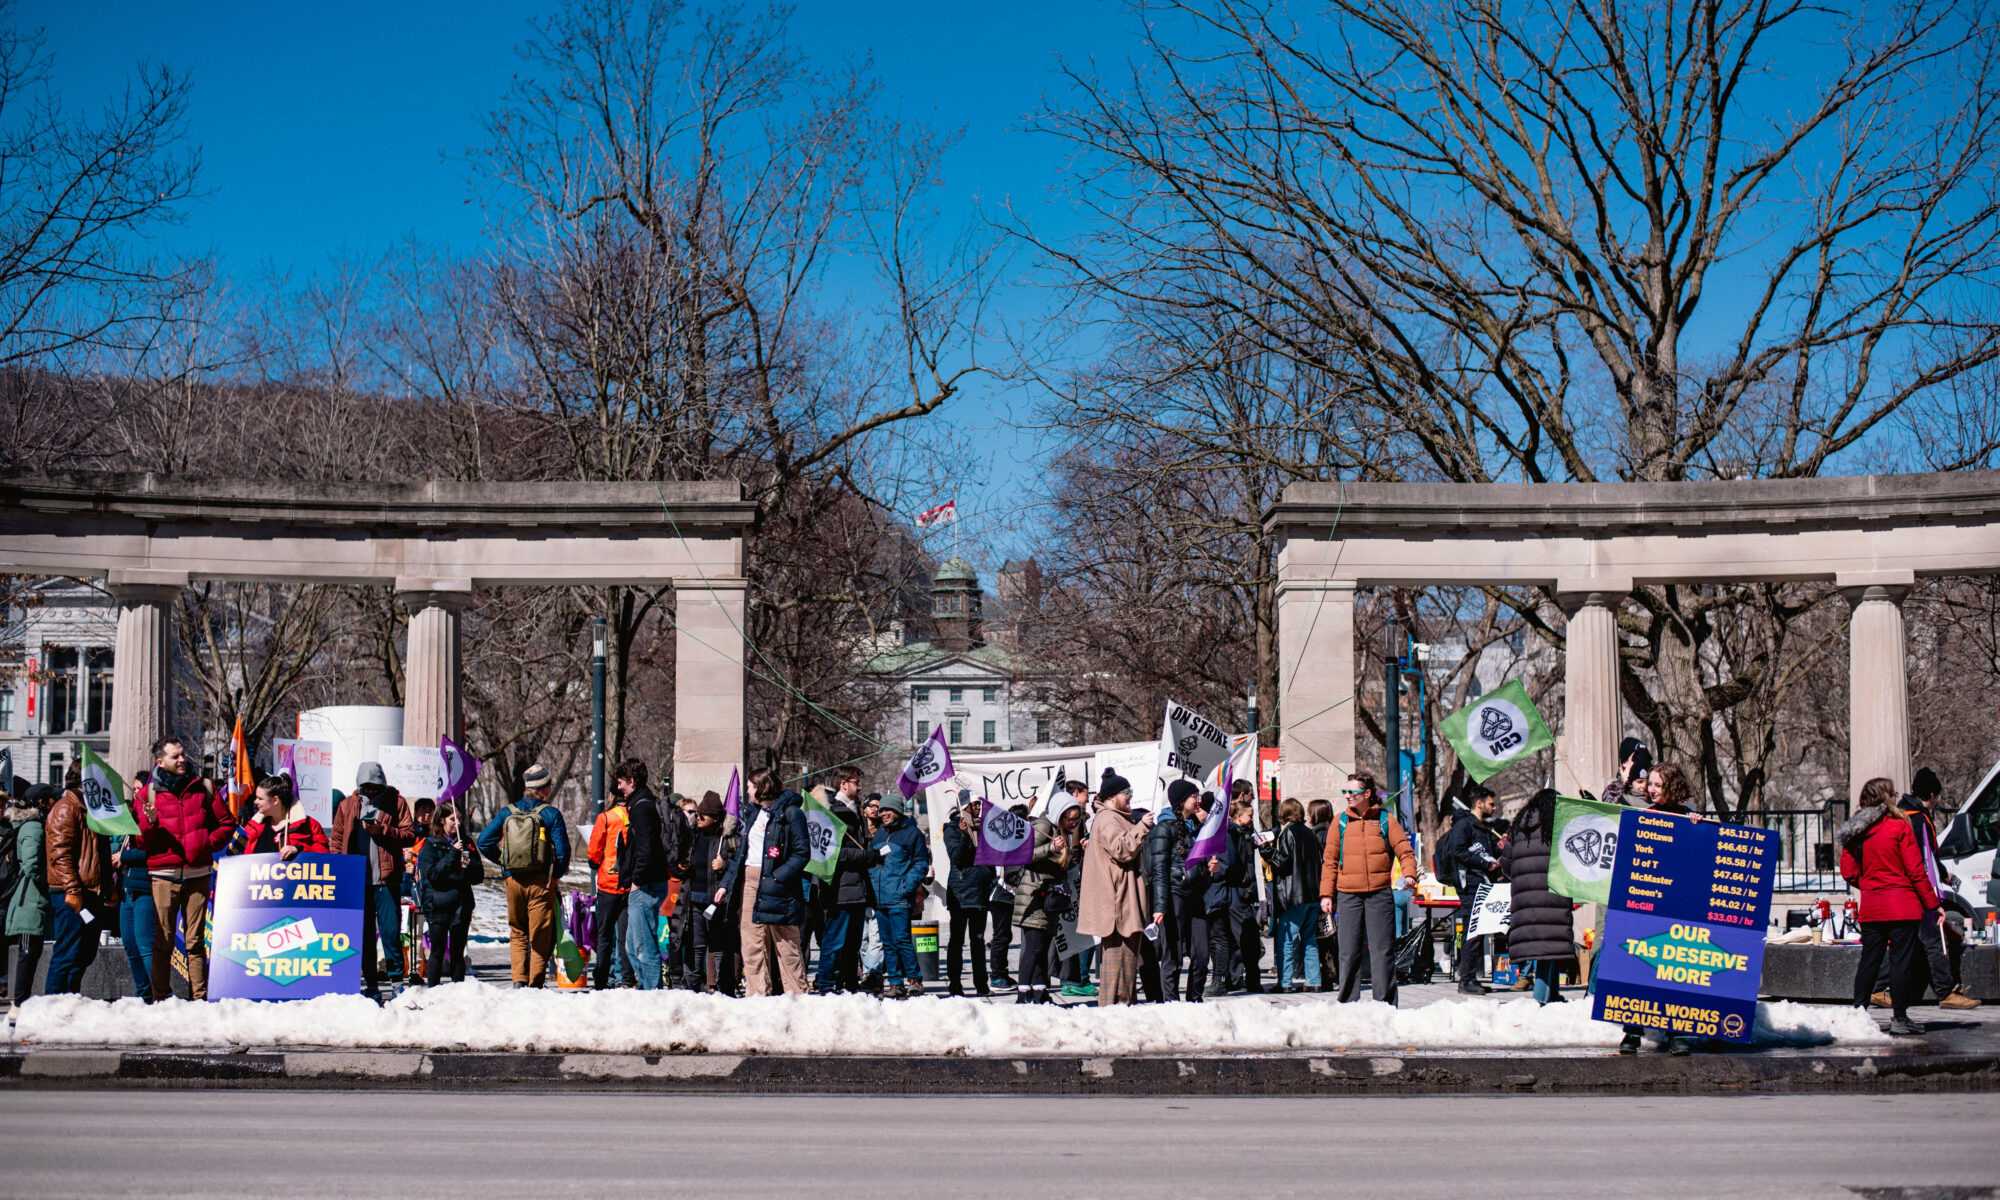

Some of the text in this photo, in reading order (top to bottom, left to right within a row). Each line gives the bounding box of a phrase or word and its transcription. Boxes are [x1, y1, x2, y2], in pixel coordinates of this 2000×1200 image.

[1171, 706, 1228, 749] ON STRIKE
[983, 761, 1097, 800] MCGIL
[1638, 816, 1674, 828] Carleton
[1718, 827, 1750, 839] $45.13
[1756, 833, 1765, 841] hr
[1636, 830, 1674, 843] UOttawa
[1717, 841, 1748, 853] $46.45
[1754, 847, 1764, 855] hr
[1635, 844, 1654, 854] York
[1715, 855, 1746, 867] $45.58
[1752, 861, 1762, 870] hr
[250, 862, 336, 881] MCGILL
[1632, 858, 1640, 866] U
[1641, 860, 1651, 868] of
[1652, 860, 1659, 869] T
[1713, 869, 1744, 881] $47.64
[1750, 875, 1760, 884] hr
[248, 884, 336, 901] TAs ARE
[1630, 872, 1673, 886] McMaster
[1711, 883, 1742, 896] $48.52
[1748, 889, 1758, 898] hr
[1628, 886, 1663, 898] Queen's
[1709, 898, 1740, 910] $44.02
[1746, 903, 1756, 912] hr
[1469, 917, 1480, 933] ON
[1626, 900, 1654, 912] McGill
[1707, 912, 1738, 924] $33.03
[1744, 917, 1754, 926] hr
[266, 924, 304, 949] ON
[319, 933, 350, 952] TO
[1670, 924, 1710, 944] OUR
[172, 947, 188, 968] CGILL
[244, 958, 333, 977] STRIKE
[1626, 938, 1748, 972] TAs DESERVE
[170, 956, 190, 982] ECAUS
[1656, 964, 1712, 986] MORE
[1605, 994, 1720, 1023] MCGILL WORKS
[1603, 1008, 1669, 1029] BECAUSE
[1672, 1018, 1694, 1033] WE
[1696, 1023, 1718, 1036] DO
